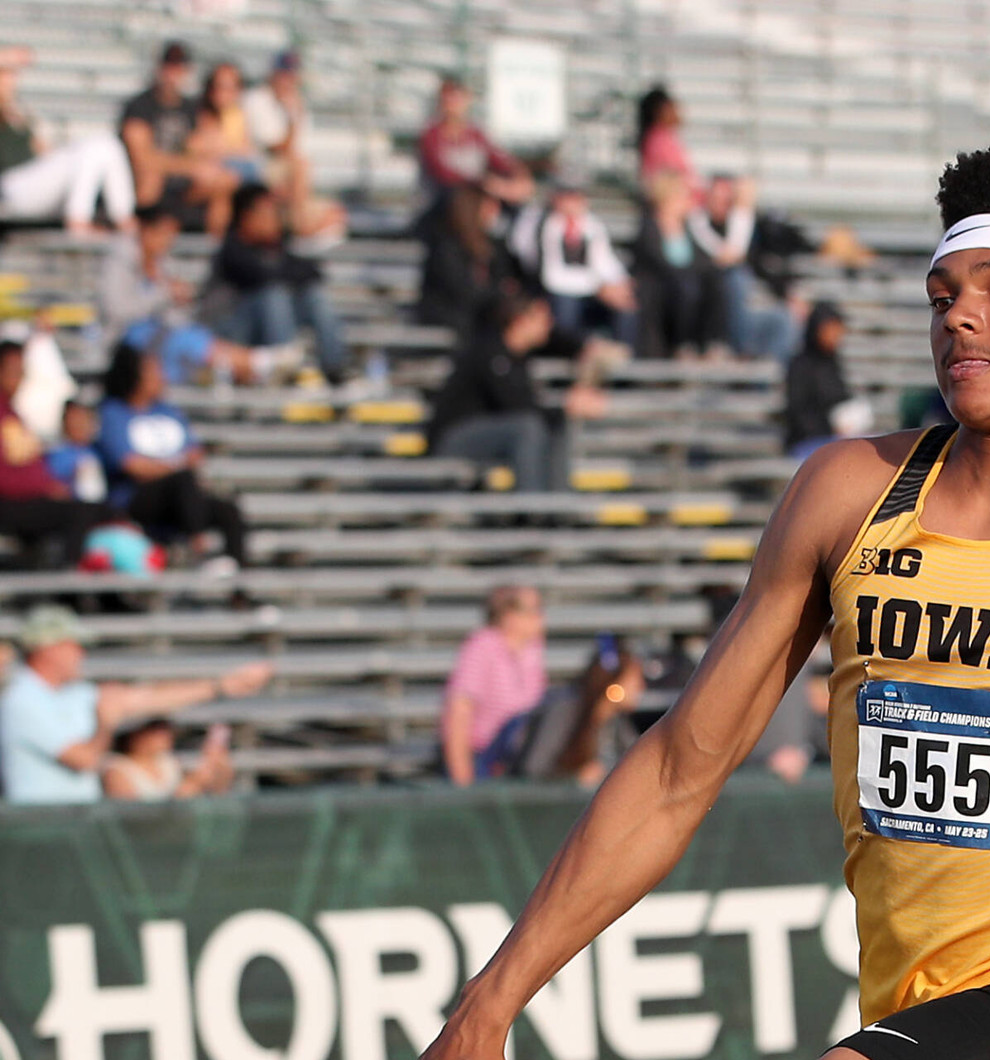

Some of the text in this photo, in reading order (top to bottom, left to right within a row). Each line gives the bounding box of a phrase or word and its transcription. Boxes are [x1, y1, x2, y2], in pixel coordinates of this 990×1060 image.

[884, 706, 907, 719] TRACK
[907, 709, 915, 721] &
[914, 709, 940, 723] FIELD
[925, 822, 935, 833] CA
[944, 825, 962, 836] MAY
[961, 827, 988, 839] 23-25
